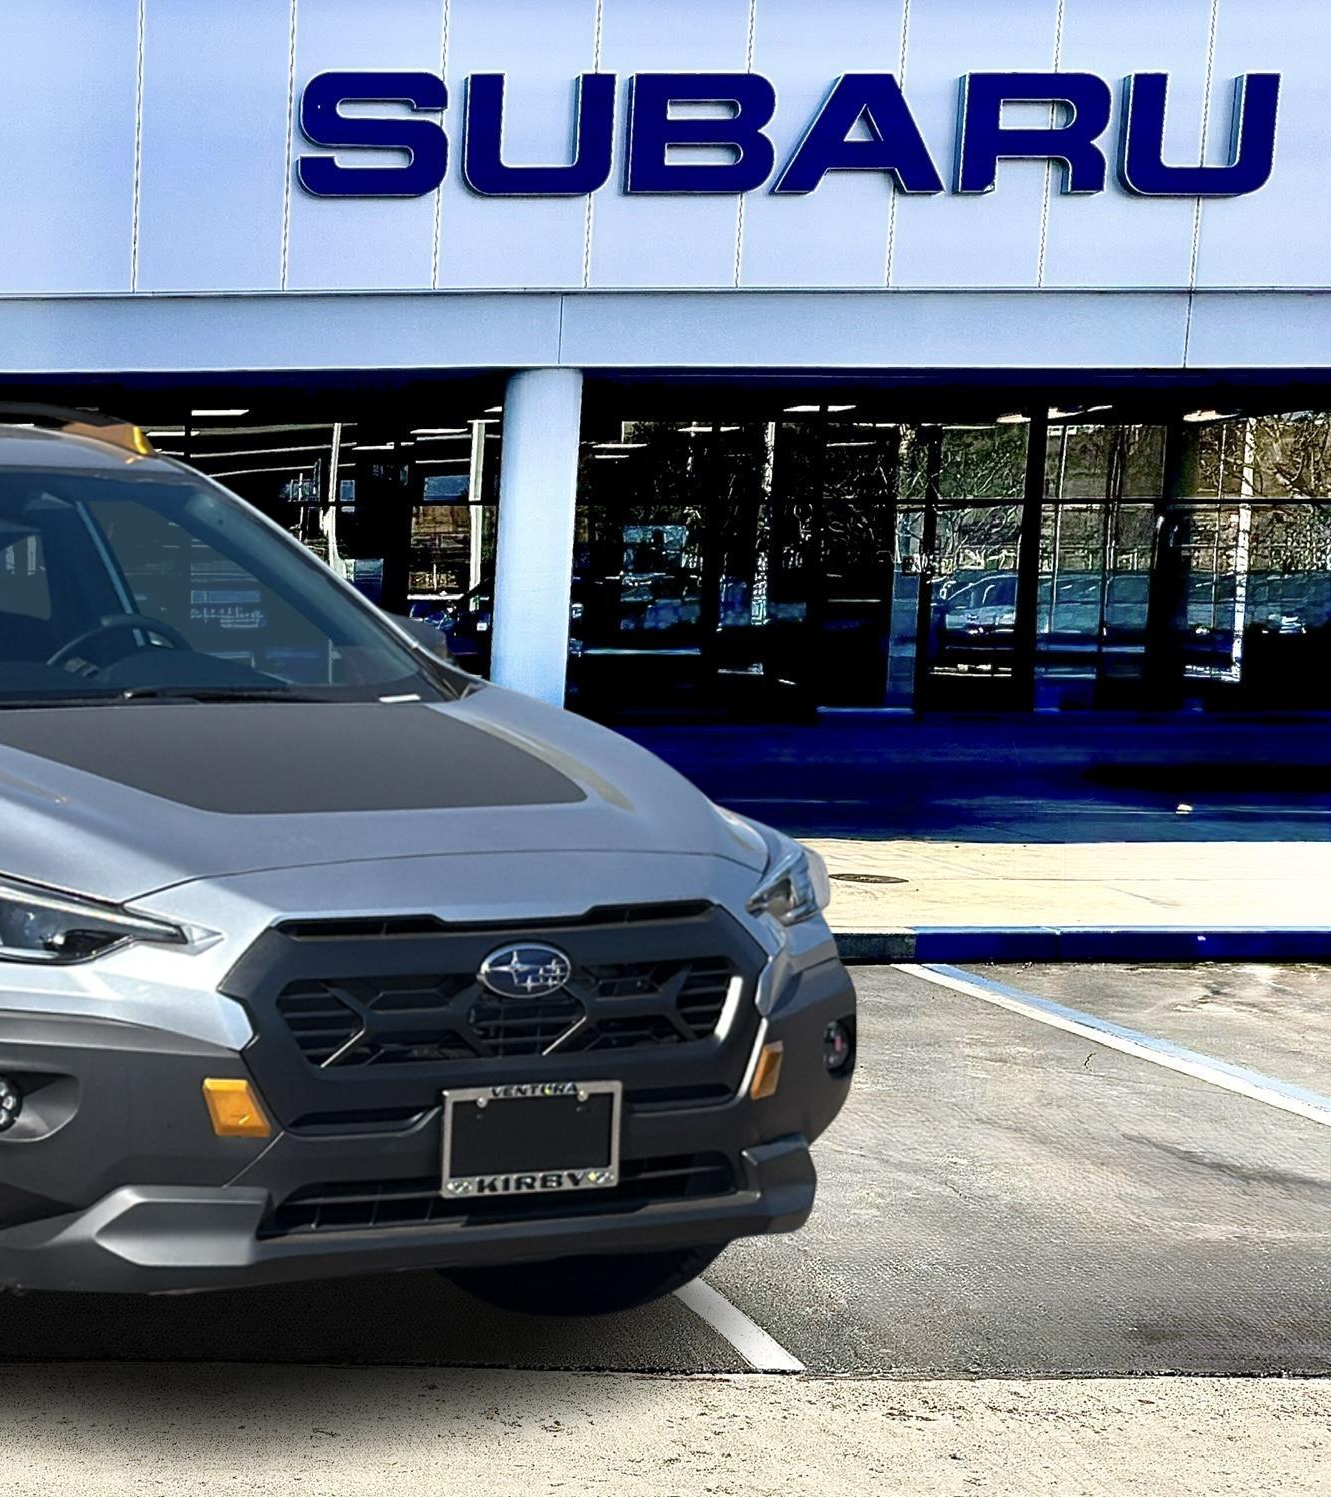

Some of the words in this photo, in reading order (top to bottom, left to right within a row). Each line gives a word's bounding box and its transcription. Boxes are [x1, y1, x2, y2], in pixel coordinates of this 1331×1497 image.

[296, 70, 1281, 198] SUBARU
[491, 1083, 578, 1097] VENTURA
[477, 1171, 586, 1193] KIRBY
